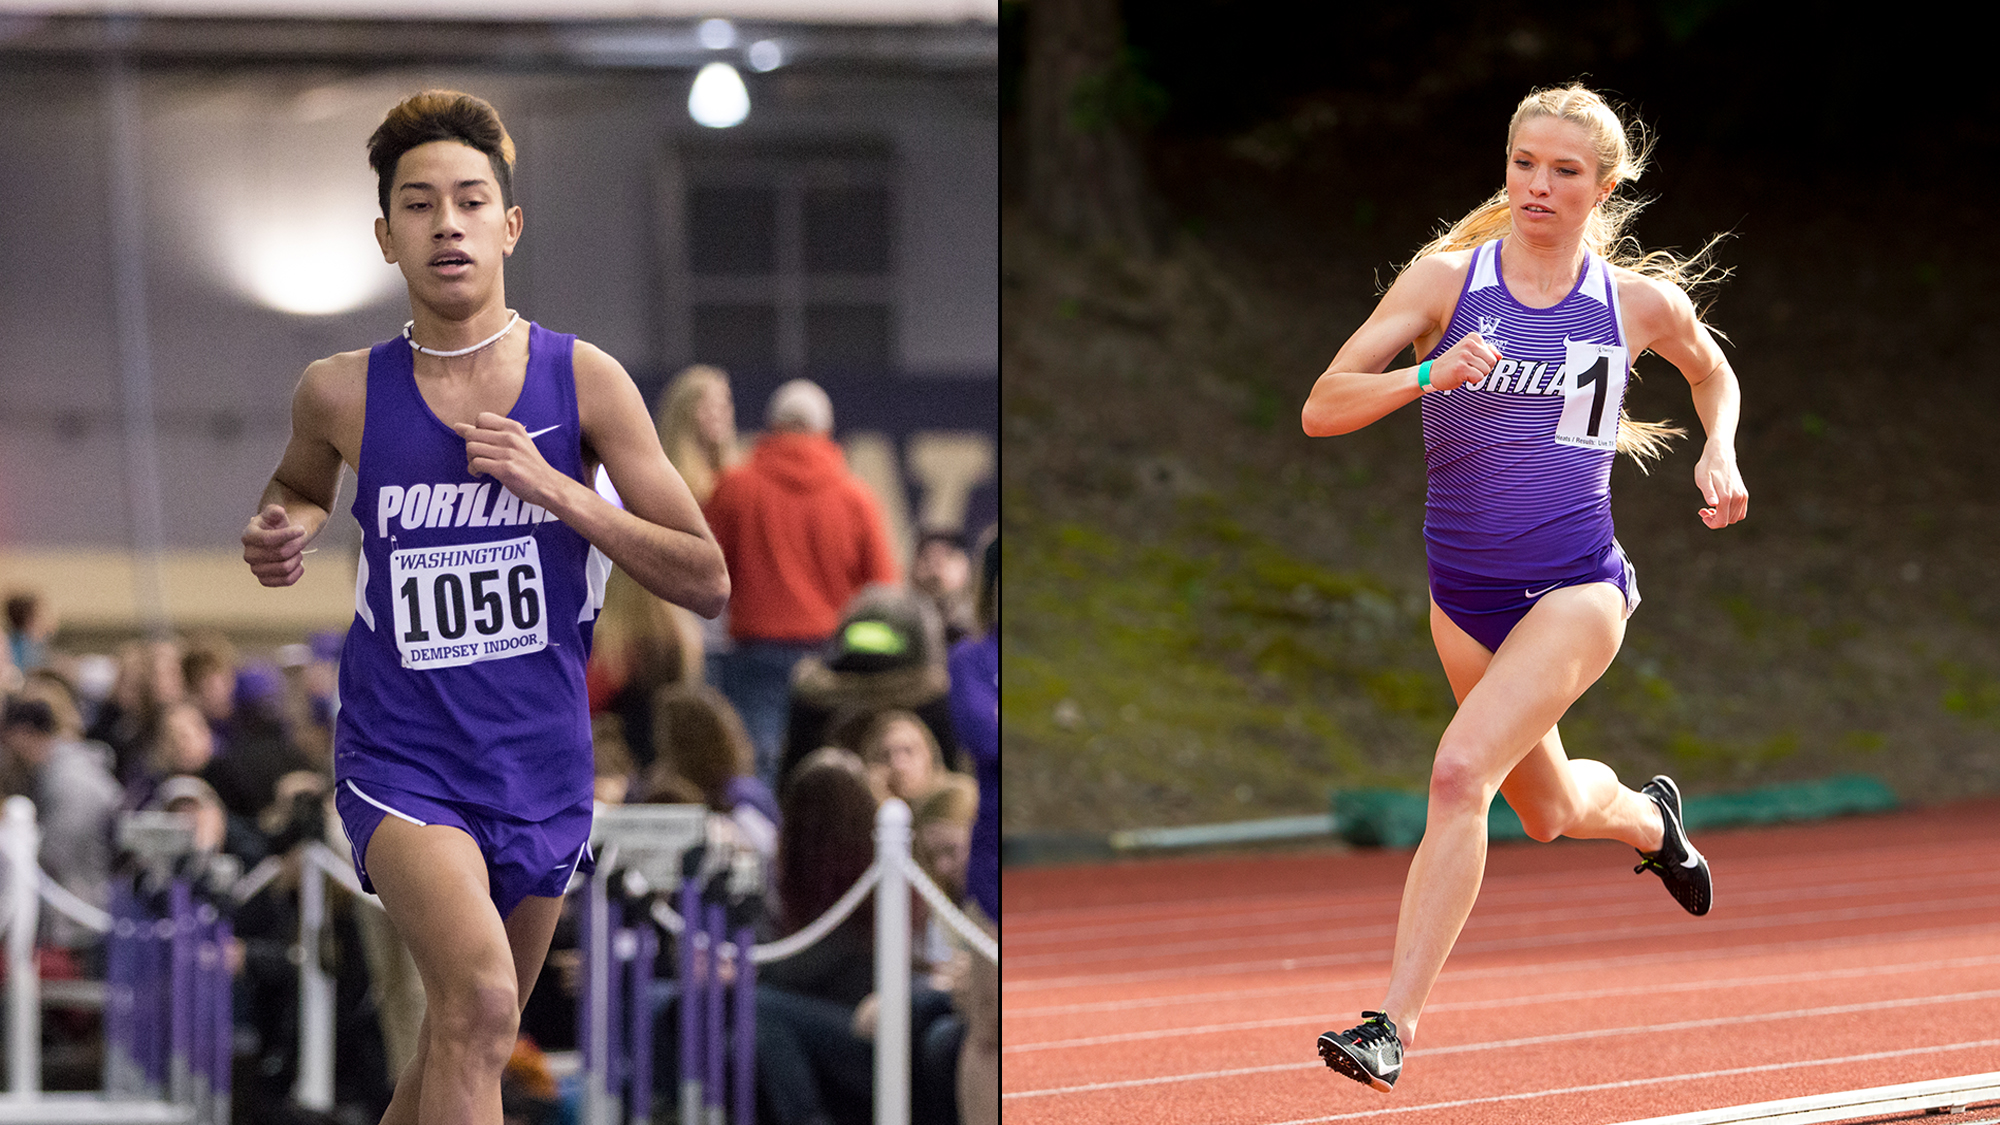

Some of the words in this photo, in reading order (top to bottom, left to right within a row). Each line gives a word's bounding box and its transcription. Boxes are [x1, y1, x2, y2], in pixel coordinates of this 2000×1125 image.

[1576, 355, 1609, 437] 1
[377, 482, 560, 539] PORTLAN
[400, 541, 529, 571] WASHINGTON
[400, 563, 541, 644] 1056
[410, 642, 479, 663] DEMPSEY
[483, 632, 539, 654] INDOOR
